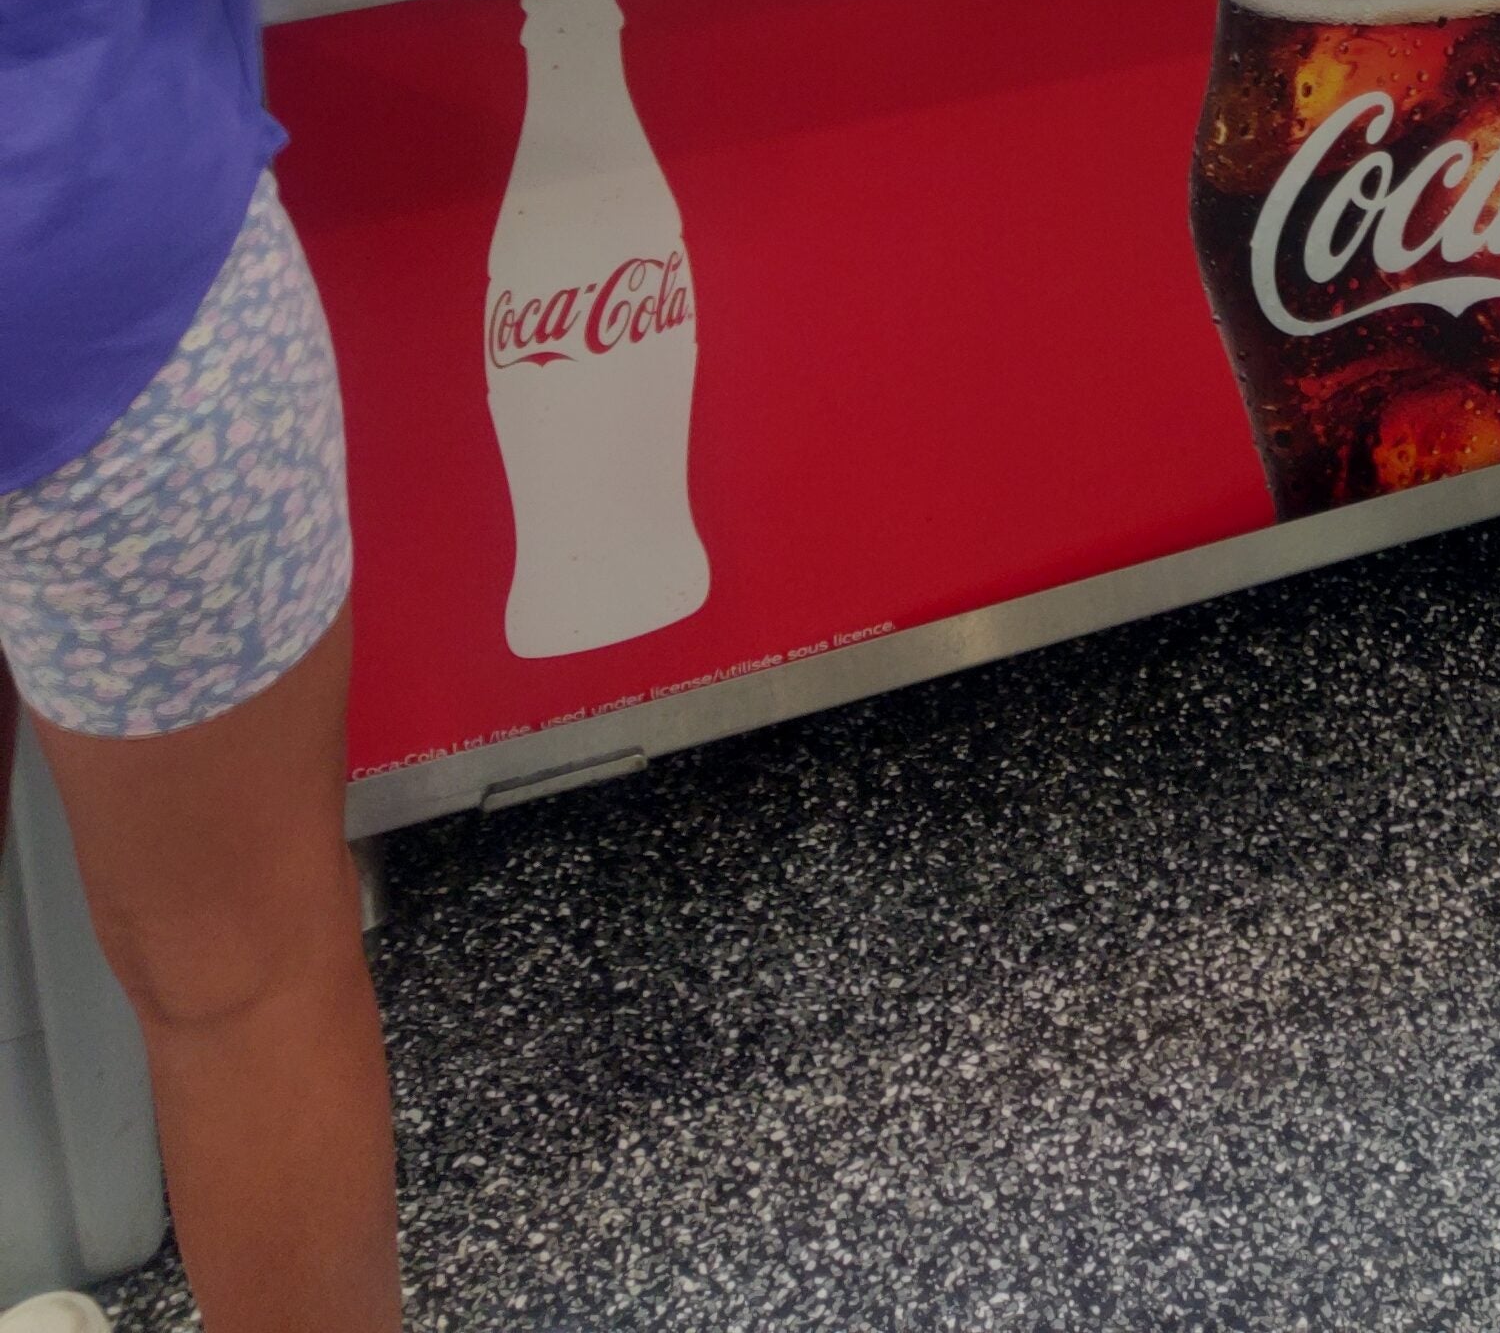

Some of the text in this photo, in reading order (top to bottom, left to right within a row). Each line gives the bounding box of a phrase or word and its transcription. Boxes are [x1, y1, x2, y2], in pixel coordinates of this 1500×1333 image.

[489, 251, 687, 369] Coca-Cola
[591, 693, 645, 716] under
[787, 639, 829, 661] sous
